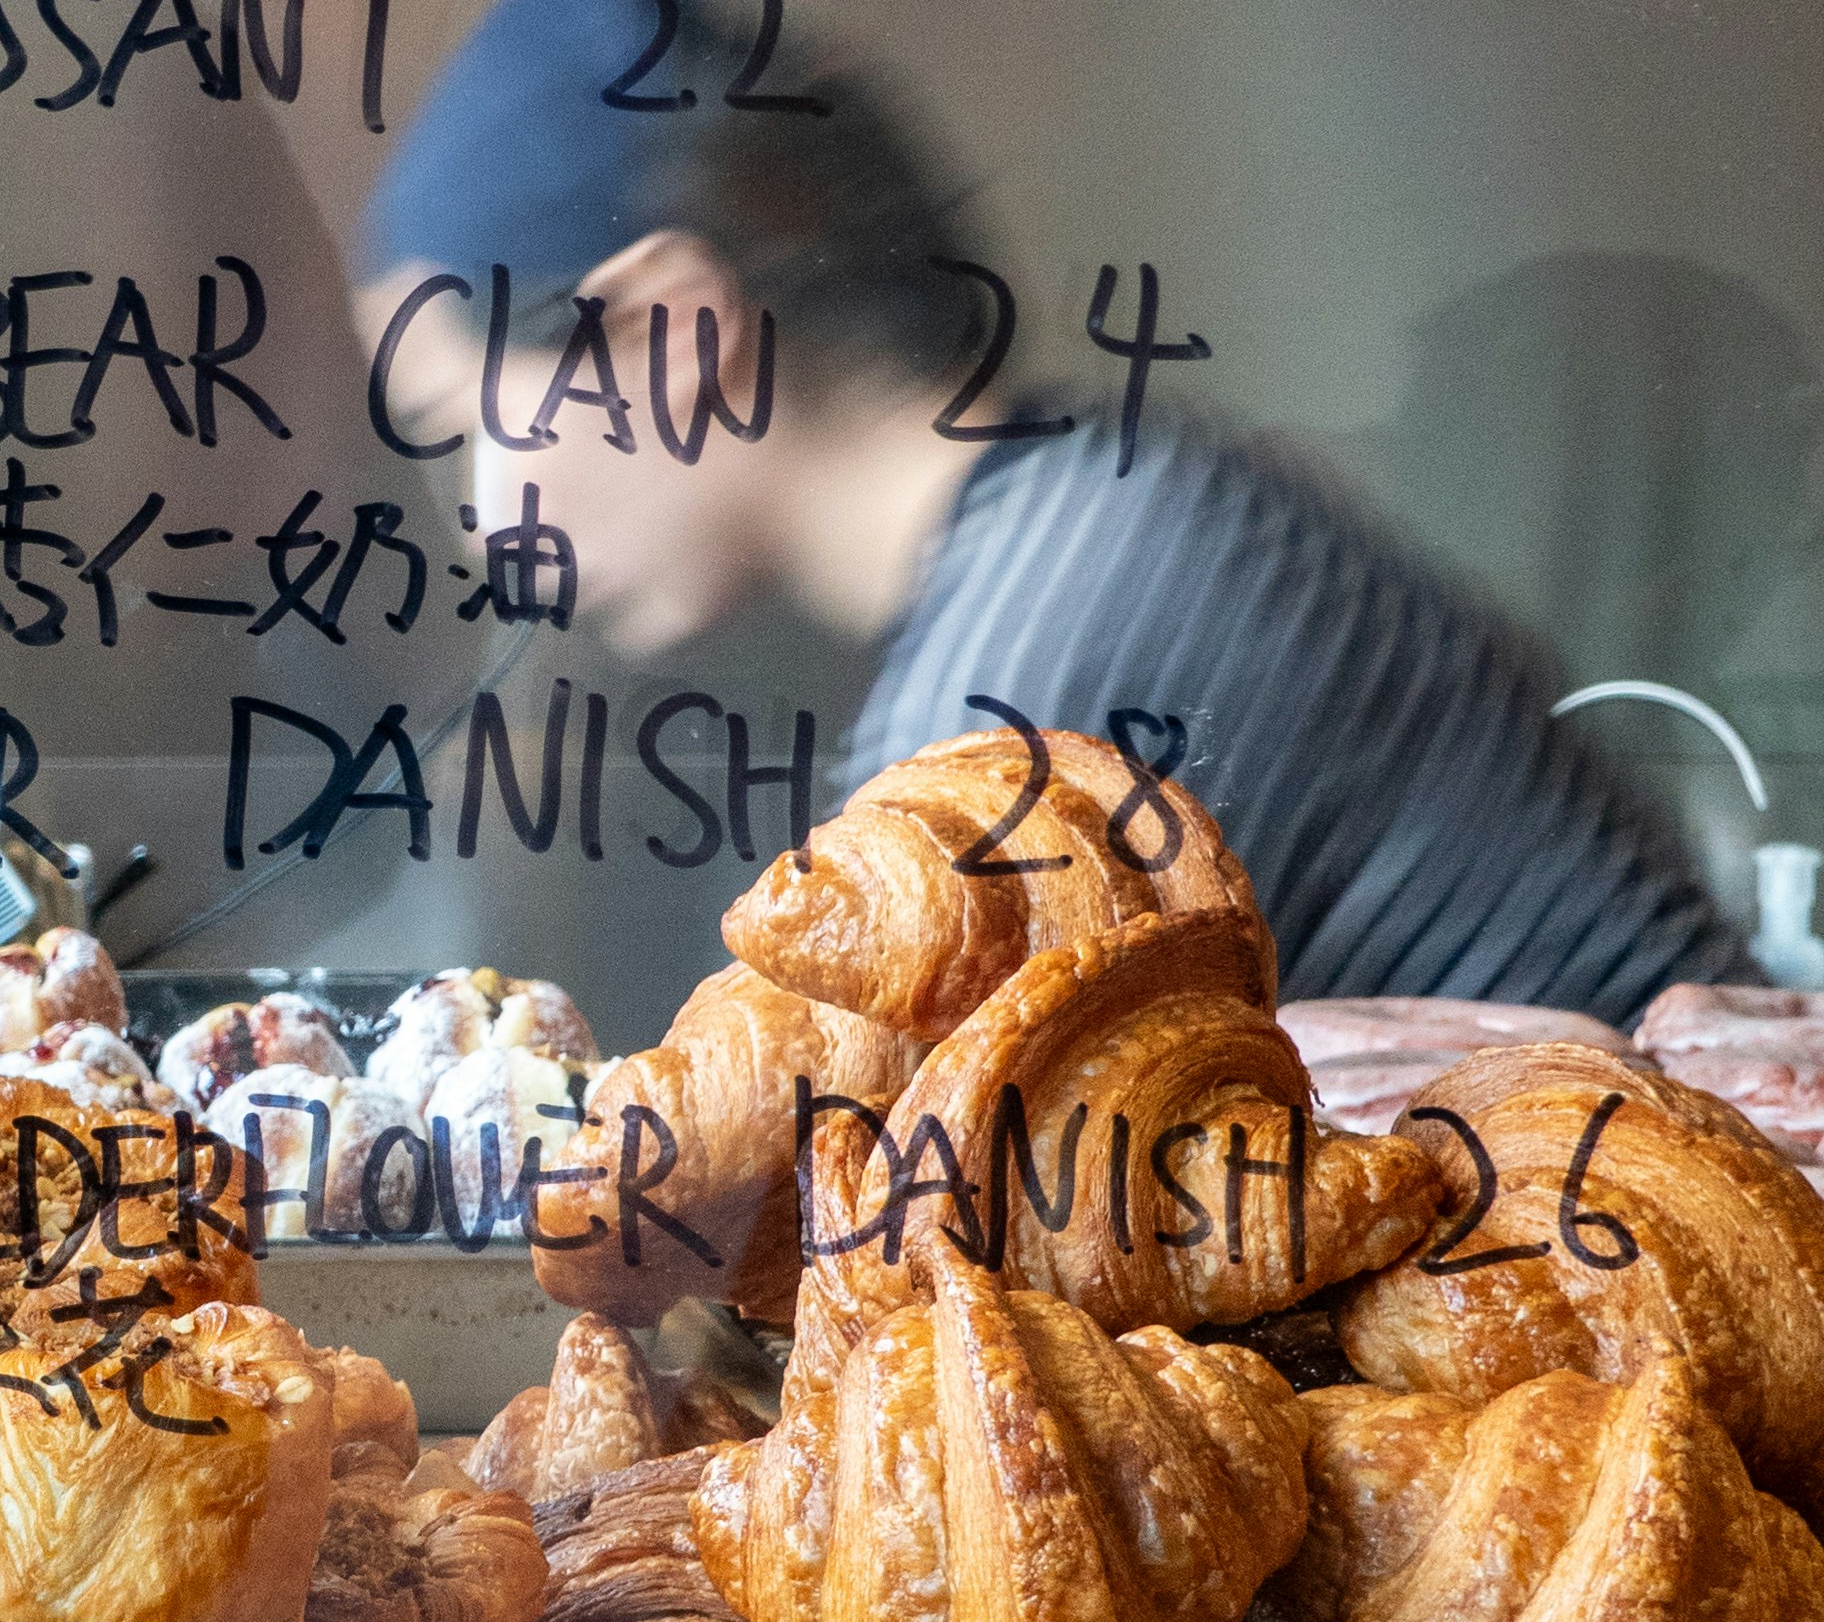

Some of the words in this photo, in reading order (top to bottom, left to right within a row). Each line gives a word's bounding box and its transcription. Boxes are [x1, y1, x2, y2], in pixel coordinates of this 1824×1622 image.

[368, 263, 774, 466] CLAW
[927, 254, 1212, 479] 24
[224, 677, 815, 875] DANISH
[951, 693, 1188, 876] 28
[793, 1073, 1307, 1285] DANISH
[1409, 1091, 1641, 1278] 26
